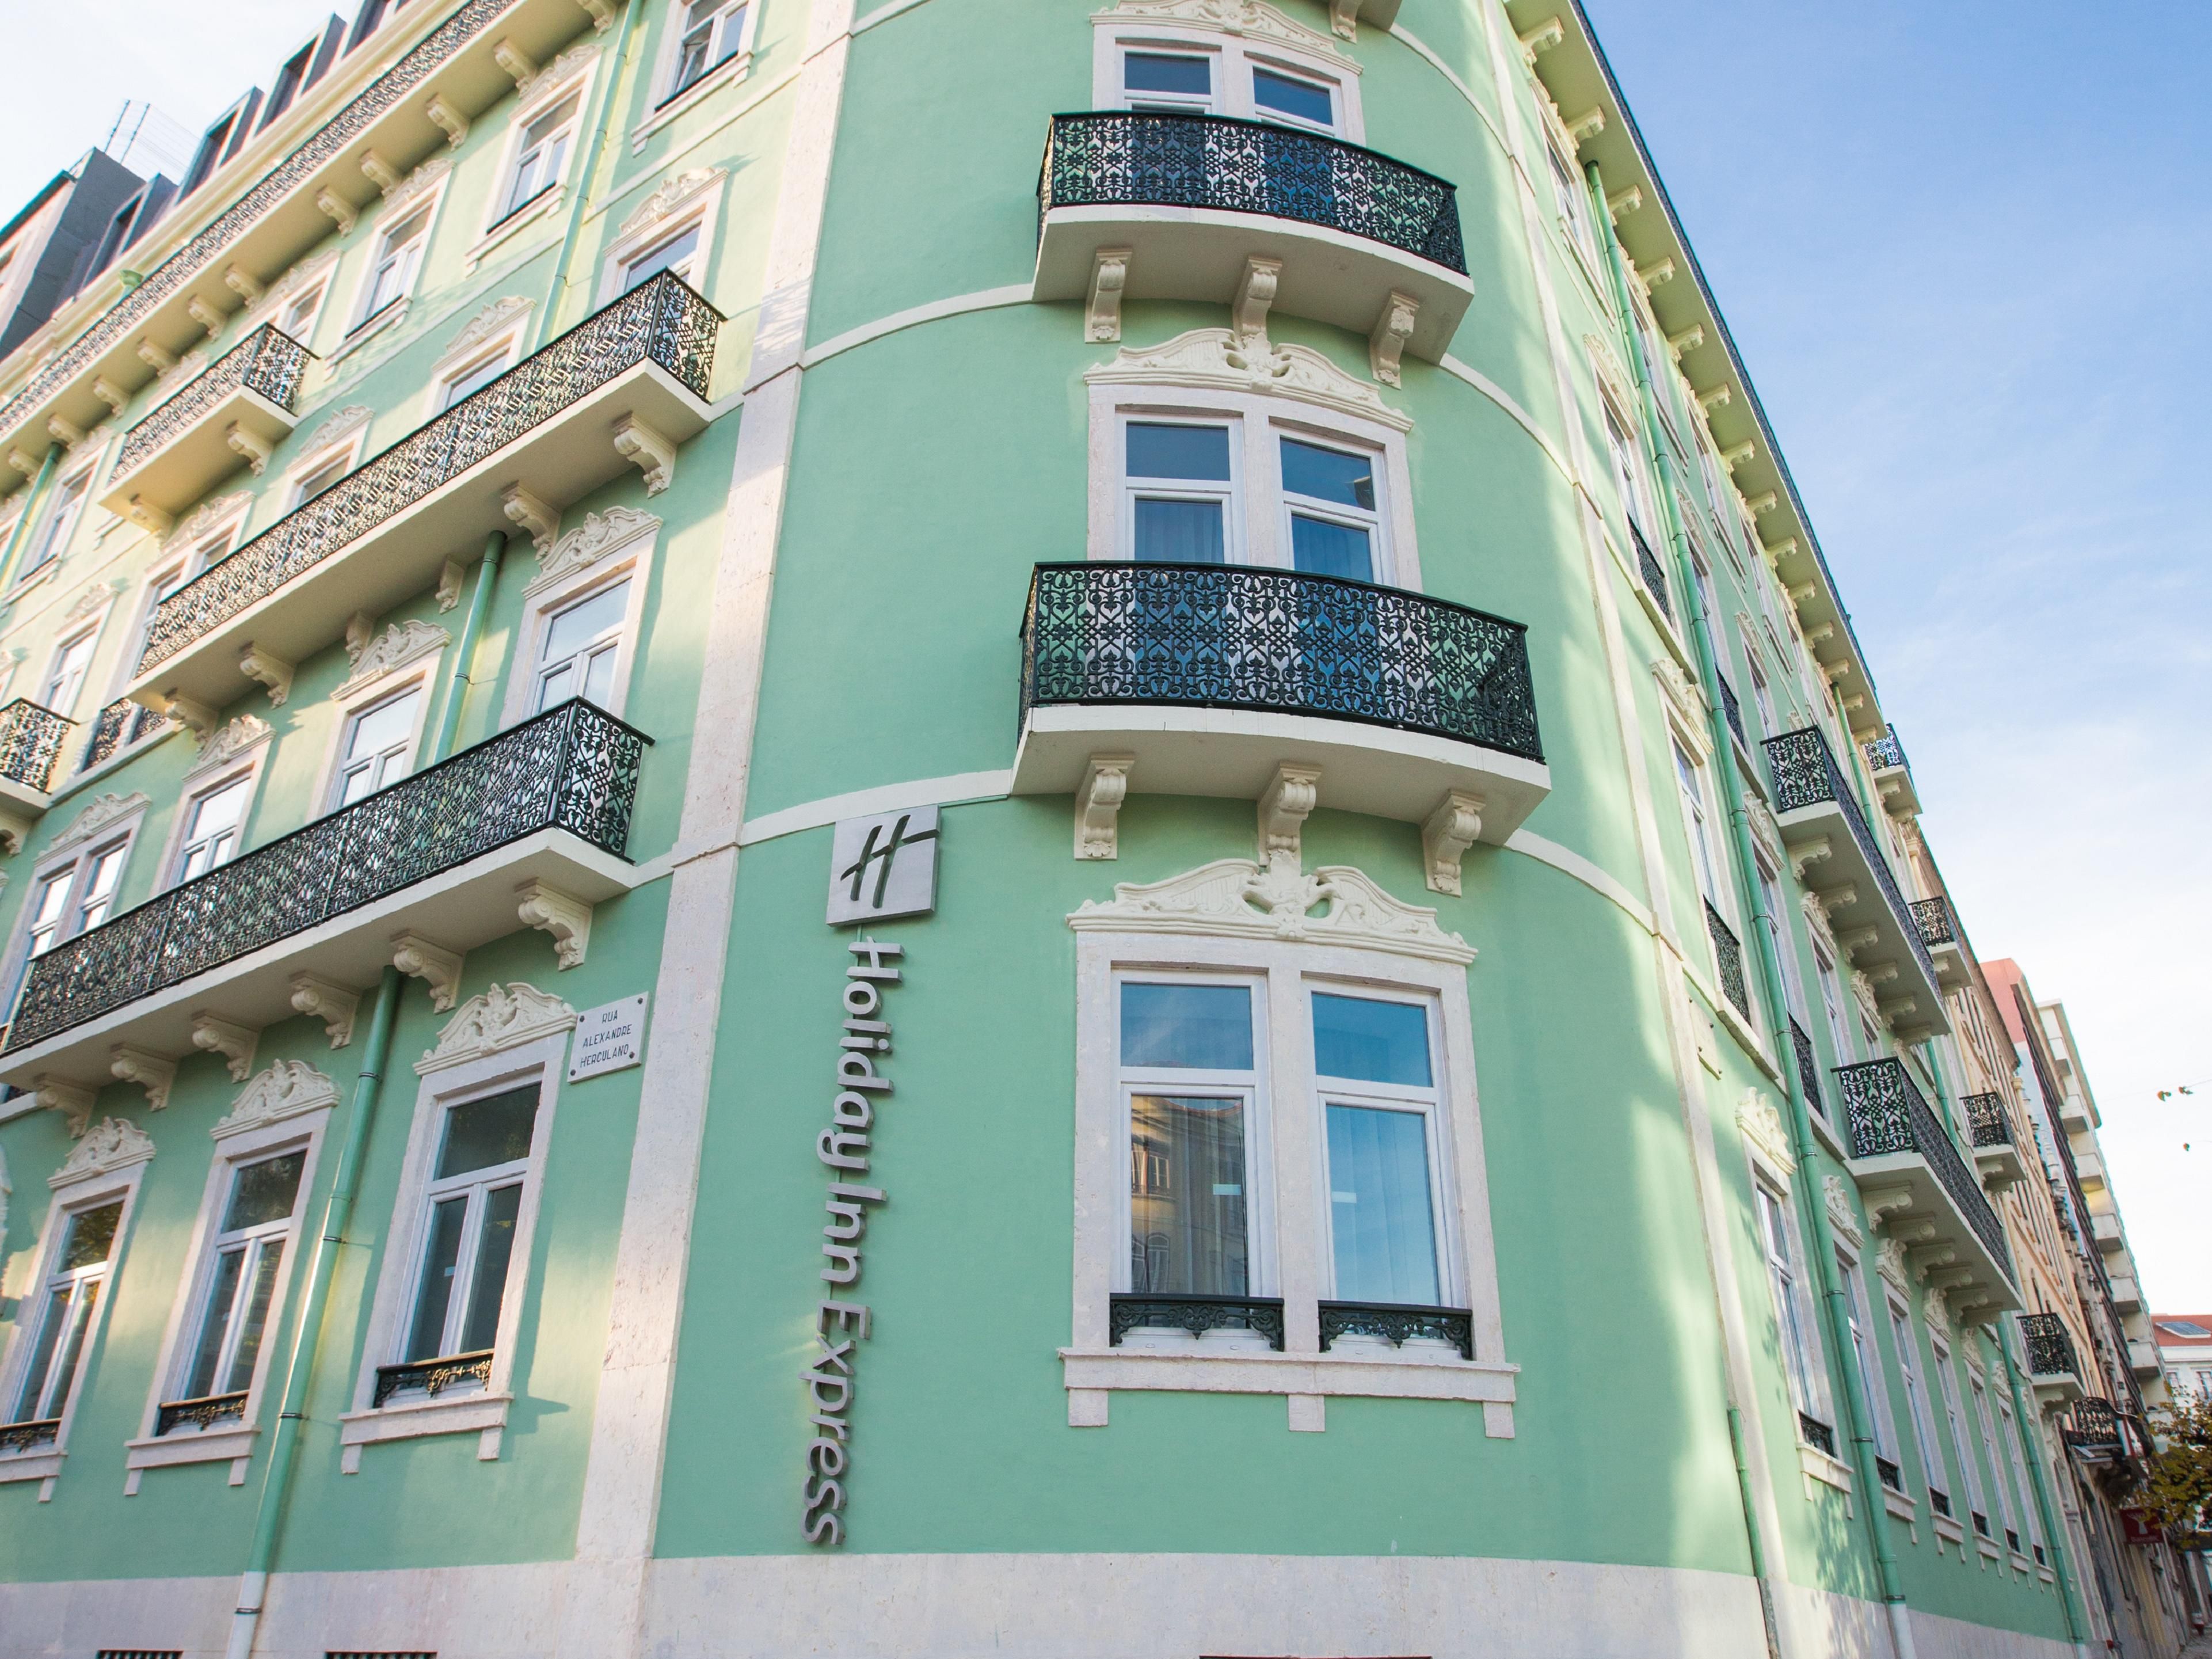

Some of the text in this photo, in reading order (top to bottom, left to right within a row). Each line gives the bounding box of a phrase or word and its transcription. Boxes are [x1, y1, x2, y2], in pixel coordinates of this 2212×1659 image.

[602, 1010, 618, 1023] RUA
[582, 1023, 632, 1048] ALEXANDRE
[580, 1044, 629, 1068] HERCULANO
[798, 937, 905, 1546] Holiday Inn Express
